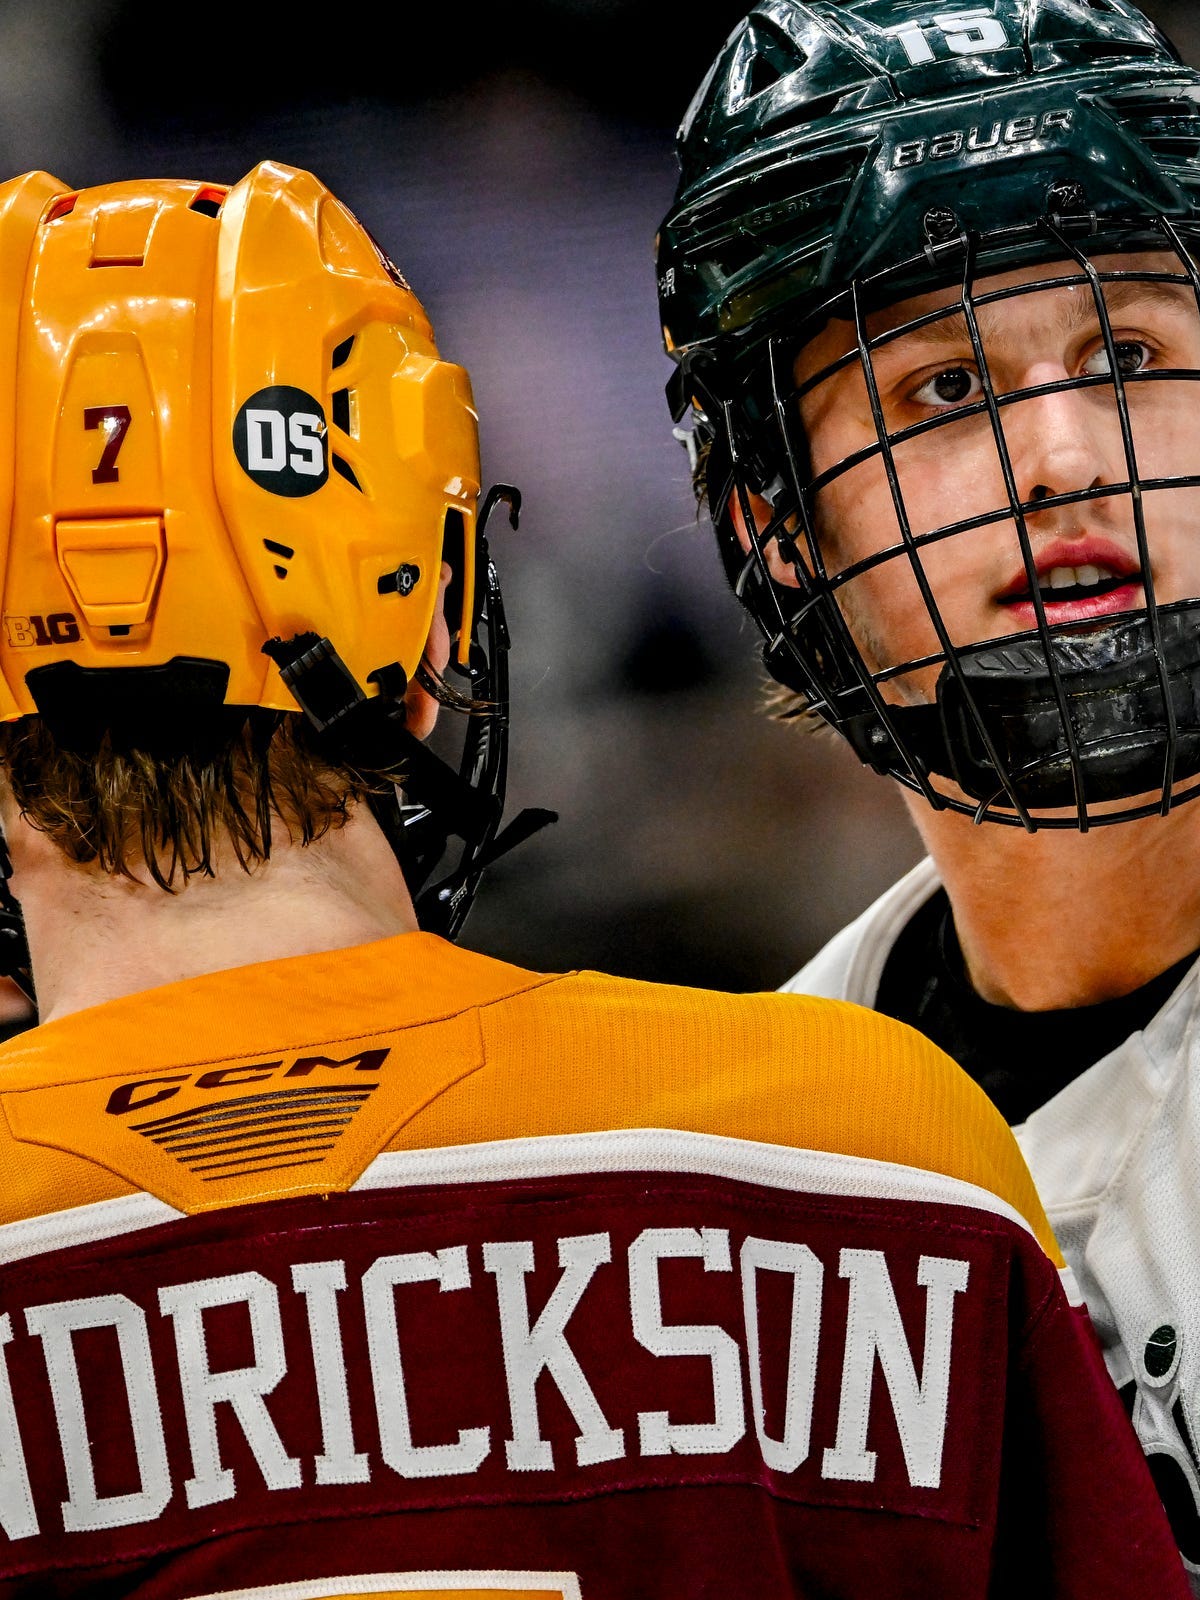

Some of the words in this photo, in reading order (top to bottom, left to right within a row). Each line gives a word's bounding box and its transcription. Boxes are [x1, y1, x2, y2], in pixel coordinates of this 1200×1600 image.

[882, 7, 1009, 66] 15
[84, 405, 132, 484] 7
[246, 408, 326, 476] DS
[105, 1047, 391, 1116] CCM
